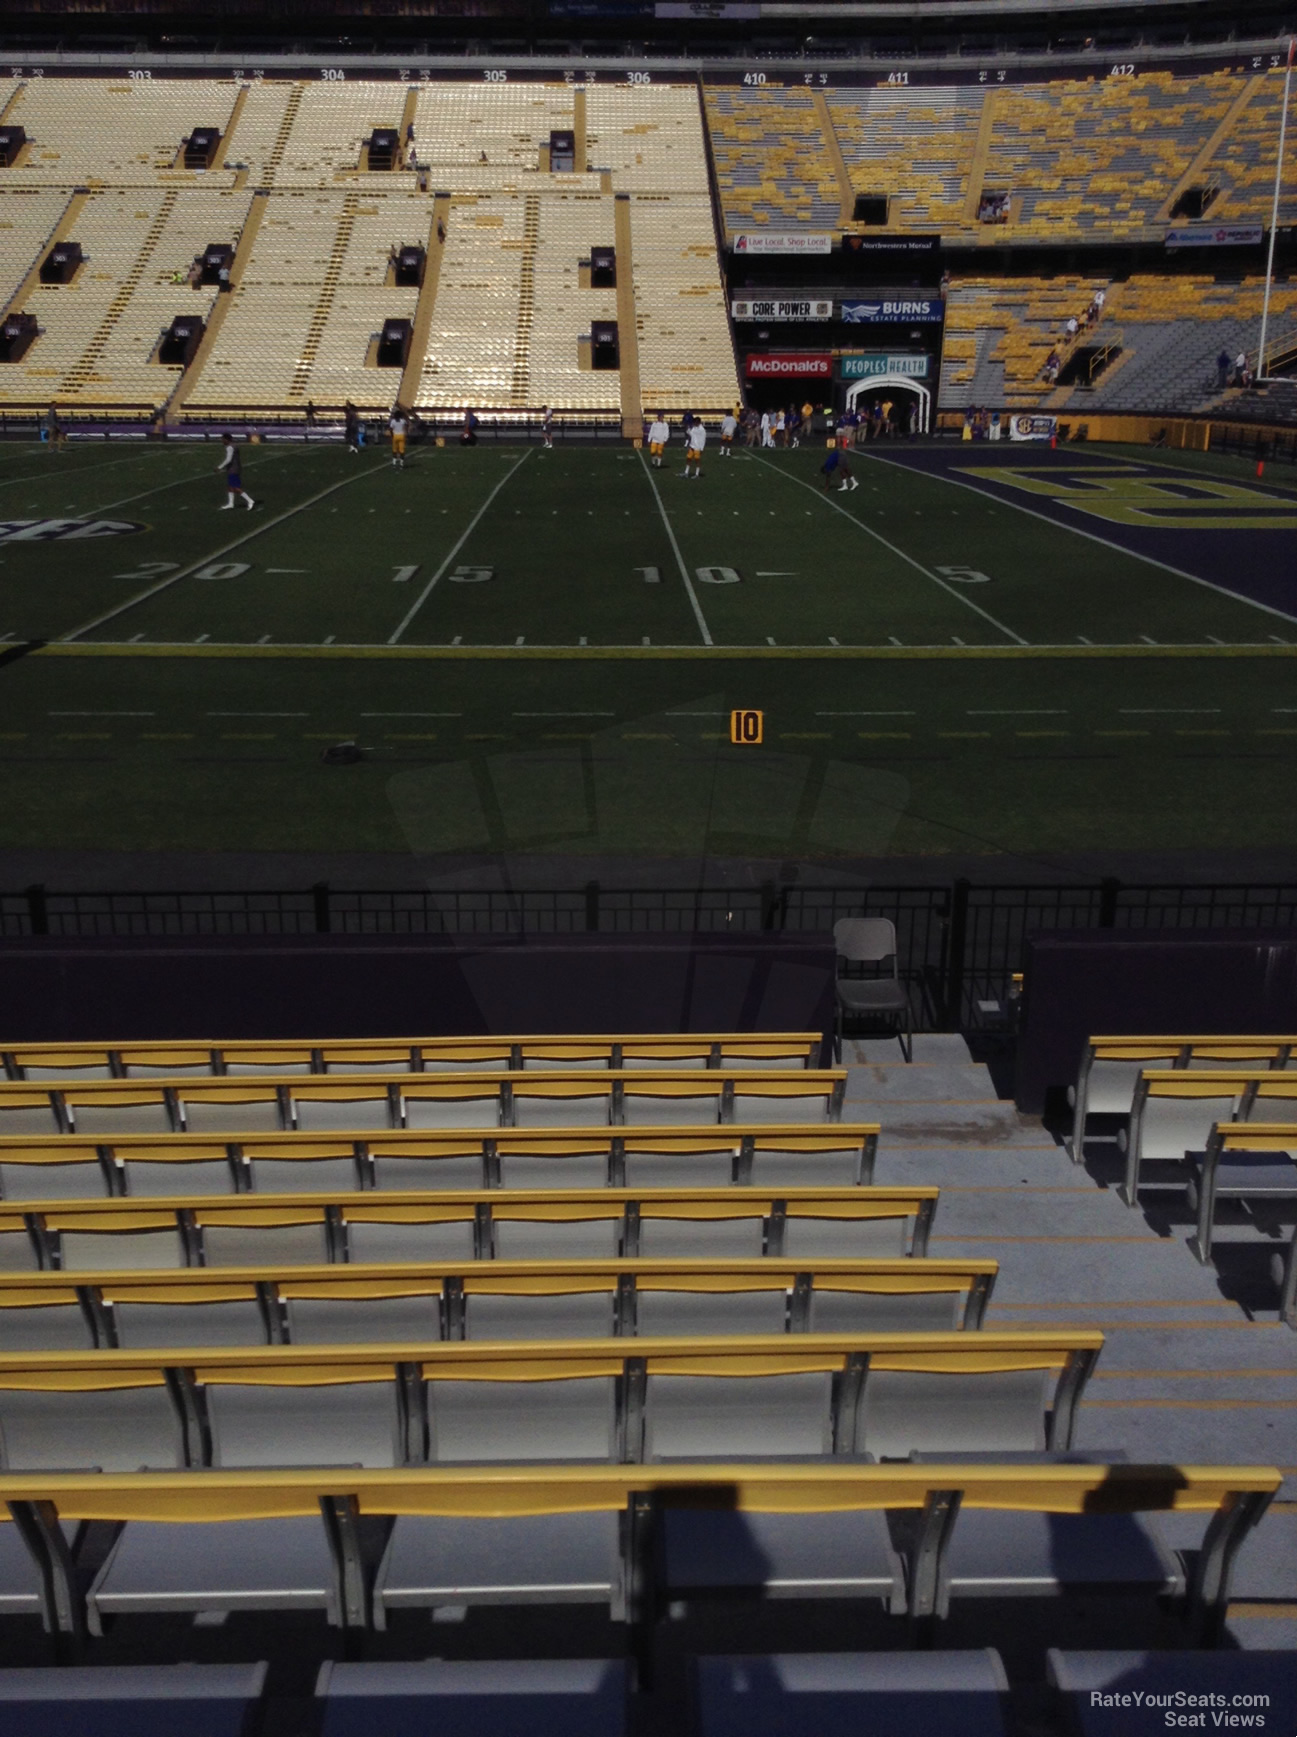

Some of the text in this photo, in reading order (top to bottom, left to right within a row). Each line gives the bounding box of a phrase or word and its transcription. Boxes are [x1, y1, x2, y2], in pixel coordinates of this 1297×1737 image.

[128, 70, 152, 79] 303
[320, 69, 346, 81] 304
[483, 70, 508, 82] 305
[1111, 64, 1135, 76] 412
[627, 72, 651, 84] 306
[743, 73, 767, 85] 410
[887, 72, 909, 84] 411
[749, 238, 764, 246] Live
[787, 238, 806, 247] Shop
[752, 302, 811, 316] CORE POWER
[883, 302, 930, 314] BURNS
[750, 360, 828, 372] McDonald's
[845, 360, 924, 374] PEOPLES HEALTH
[391, 565, 494, 583] 15
[633, 565, 742, 584] 10
[933, 565, 992, 583] 5
[735, 711, 759, 742] 10
